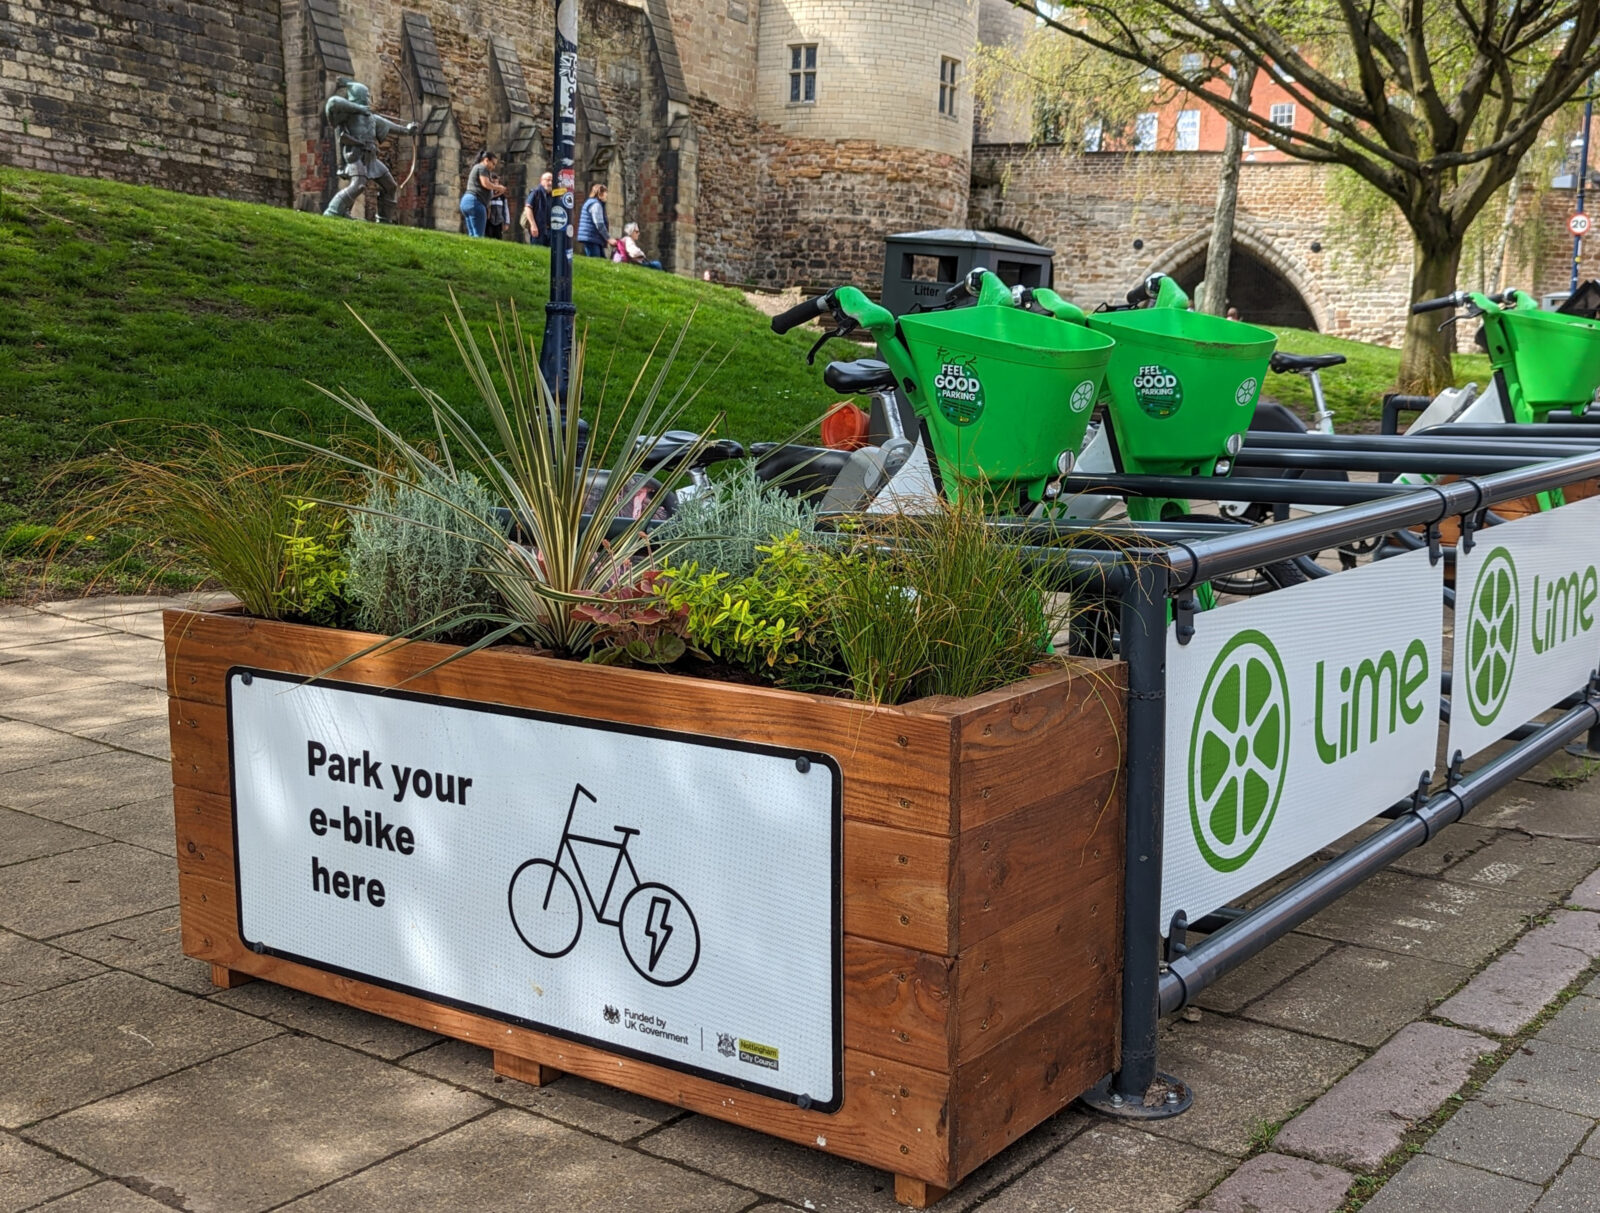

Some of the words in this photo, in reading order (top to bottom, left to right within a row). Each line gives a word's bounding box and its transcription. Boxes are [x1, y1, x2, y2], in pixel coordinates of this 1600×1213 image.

[1571, 219, 1587, 229] 20
[914, 285, 940, 296] Litter
[941, 364, 965, 376] FEEL
[1139, 365, 1162, 375] FEEL
[934, 374, 980, 393] GOOD
[1133, 375, 1177, 388] GOOD
[942, 389, 976, 401] PARKING
[1141, 388, 1174, 396] PARKING
[307, 740, 384, 790] Park
[391, 764, 473, 806] your
[309, 805, 415, 855] e-bike
[311, 856, 386, 908] here
[624, 1008, 654, 1025] Funded
[656, 1017, 667, 1030] by
[624, 1019, 638, 1031] UK
[638, 1023, 689, 1045] Government
[740, 1041, 777, 1057] Nottingham
[740, 1052, 753, 1063] City
[754, 1056, 777, 1069] Council
